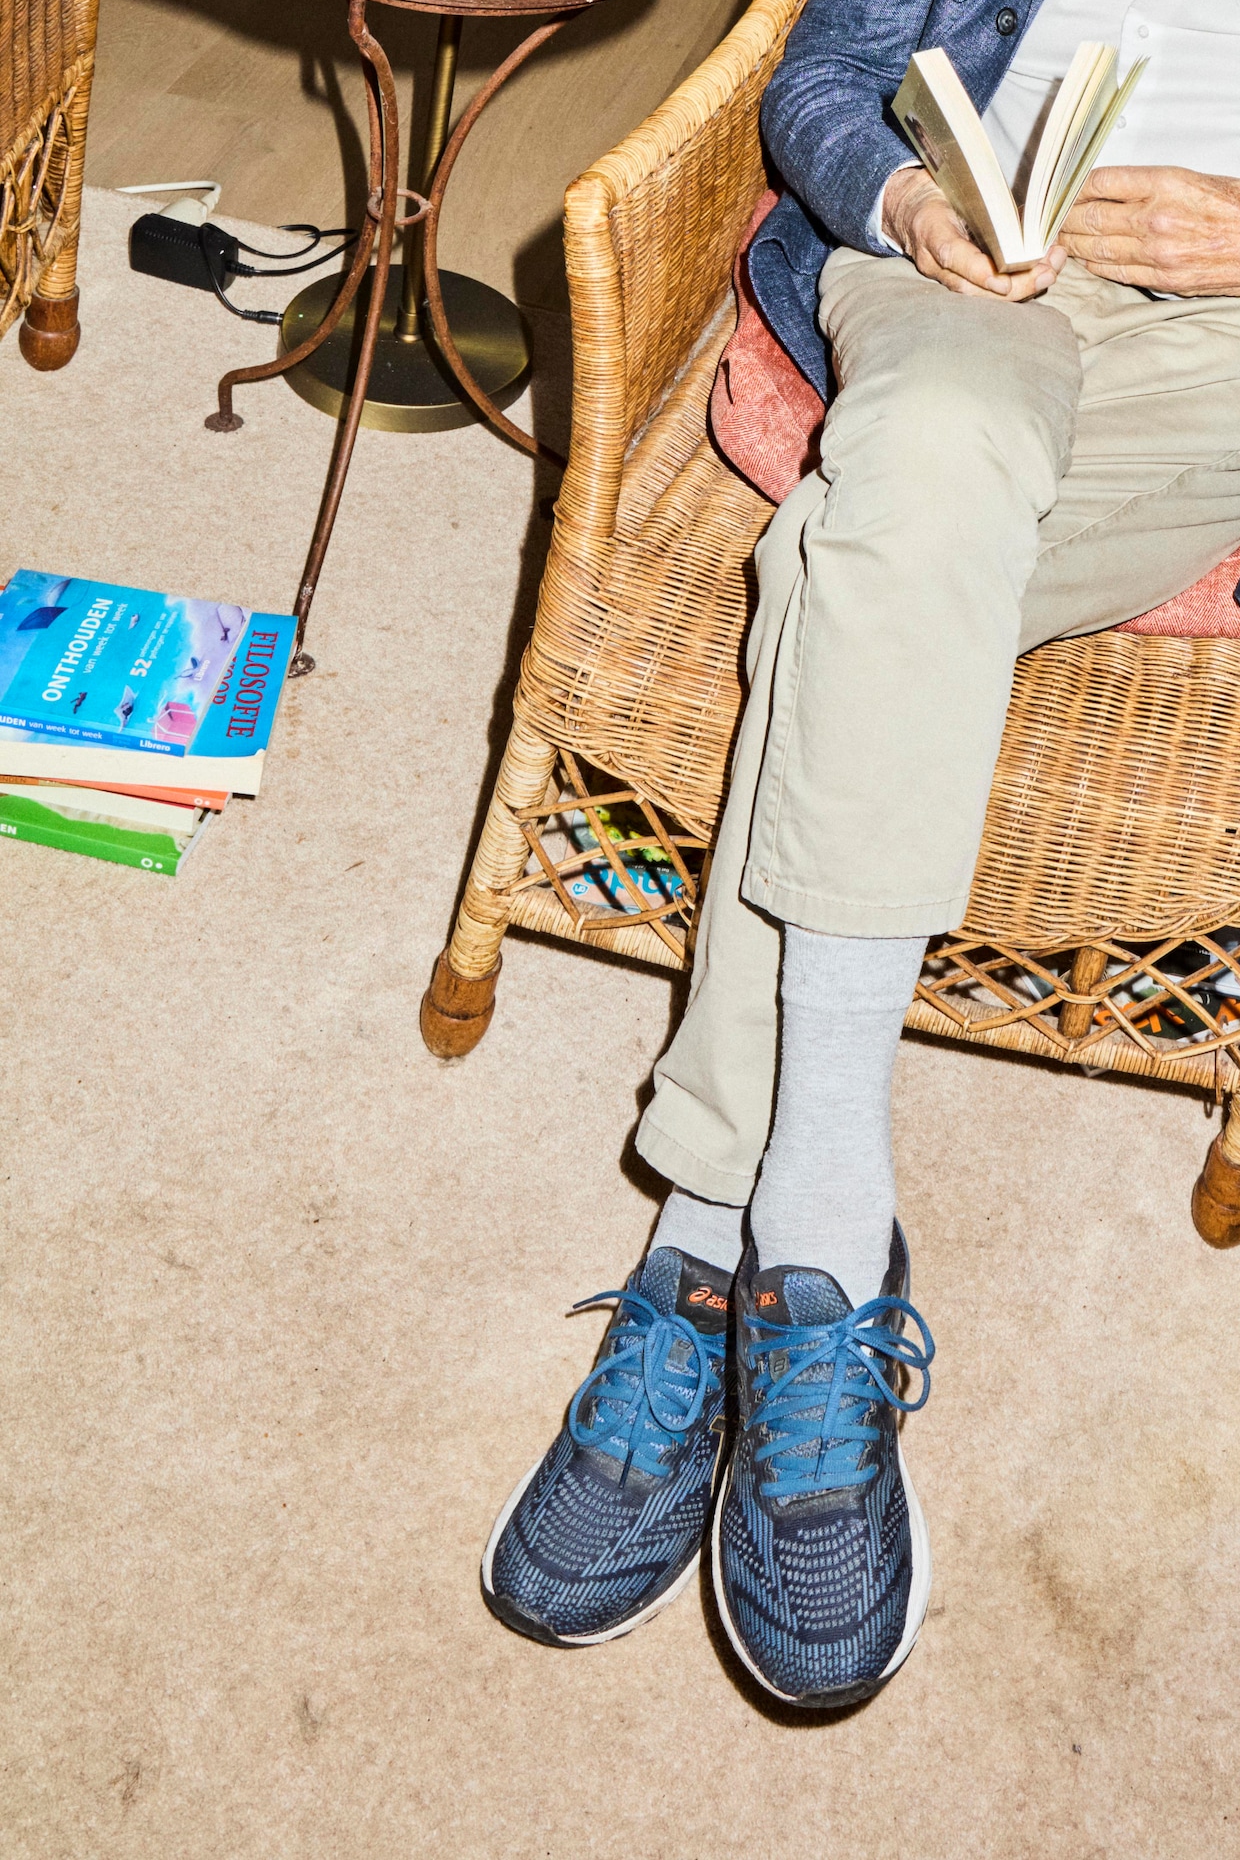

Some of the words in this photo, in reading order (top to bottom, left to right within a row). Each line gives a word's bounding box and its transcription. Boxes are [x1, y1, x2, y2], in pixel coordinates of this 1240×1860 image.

[42, 597, 113, 702] ONTHOUDEN
[82, 660, 97, 674] van
[95, 634, 110, 658] week
[104, 619, 117, 635] tot
[112, 602, 129, 623] week
[129, 659, 152, 678] 52
[225, 630, 278, 738] FILOSOFIE
[29, 722, 43, 730] van
[46, 725, 66, 734] week
[69, 728, 80, 736] tot
[81, 730, 103, 740] week
[139, 740, 171, 752] Librero
